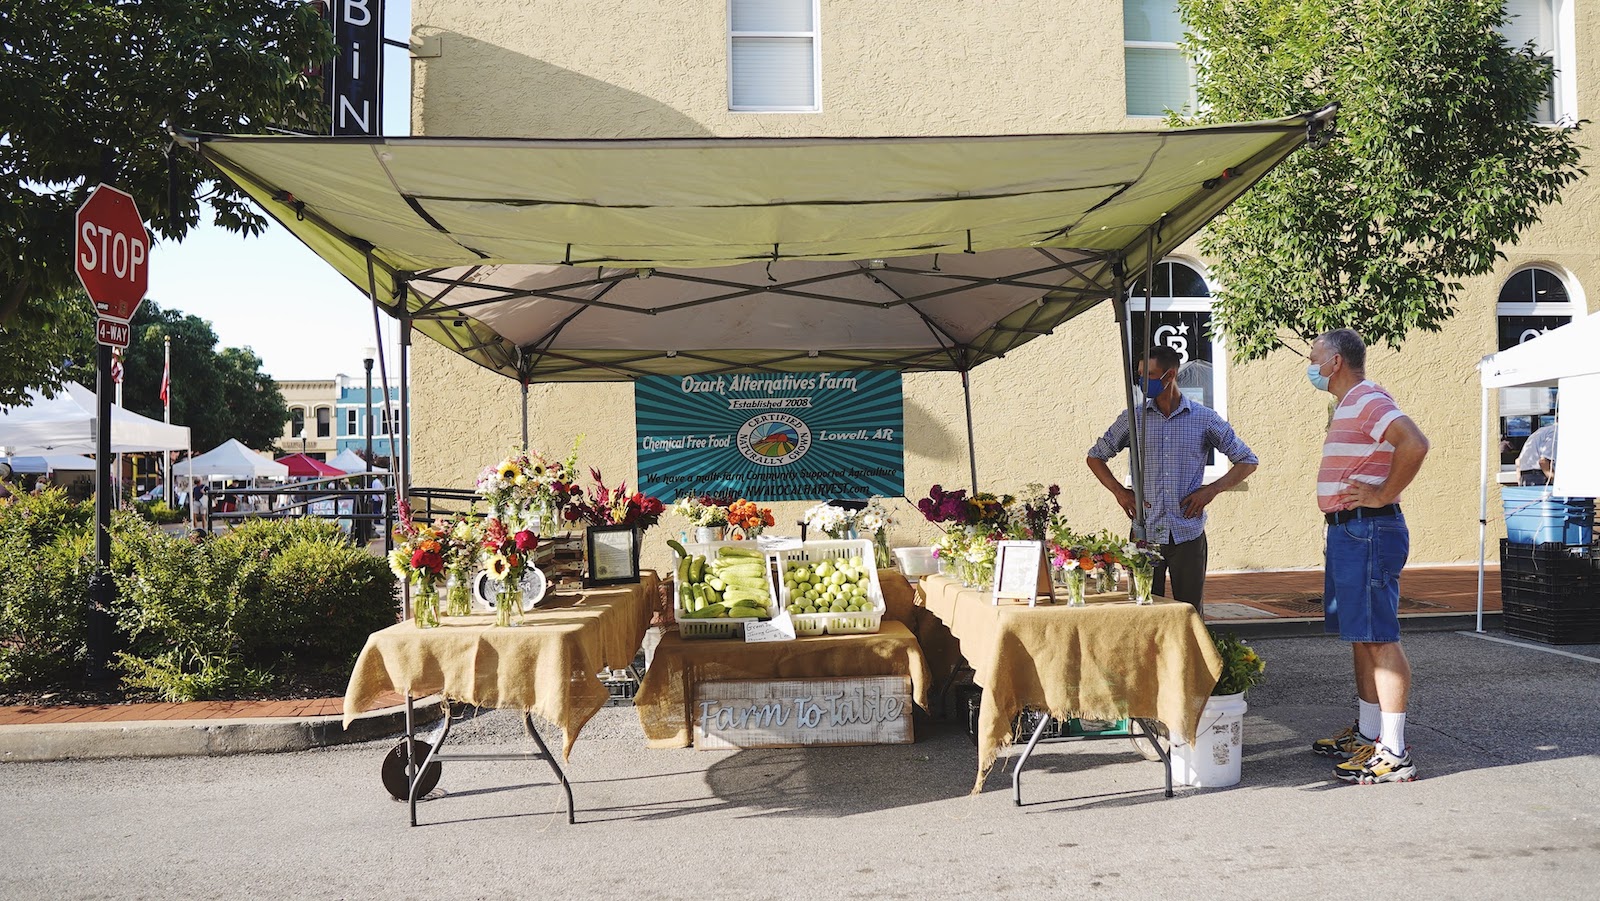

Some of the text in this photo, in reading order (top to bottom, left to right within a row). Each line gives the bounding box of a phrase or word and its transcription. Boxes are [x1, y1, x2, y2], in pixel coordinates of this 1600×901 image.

[80, 221, 145, 283] STOP
[99, 324, 128, 342] 4-WAY
[681, 372, 858, 395] Ozark Alternatives Farm
[732, 398, 809, 409] Established 2008
[748, 414, 803, 429] CERTIFIED
[642, 433, 731, 453] Chemical Free Food
[819, 428, 894, 441] Lowell, AR
[739, 432, 809, 465] NATURALLY GROWN
[646, 473, 661, 483] We
[662, 473, 685, 484] have
[687, 474, 693, 482] a
[746, 469, 798, 481] Community
[800, 468, 846, 480] Supported
[848, 467, 897, 478] Agriculture
[745, 482, 870, 497] NWALOCALHARVEST.com
[699, 685, 904, 739] Farm To Table
